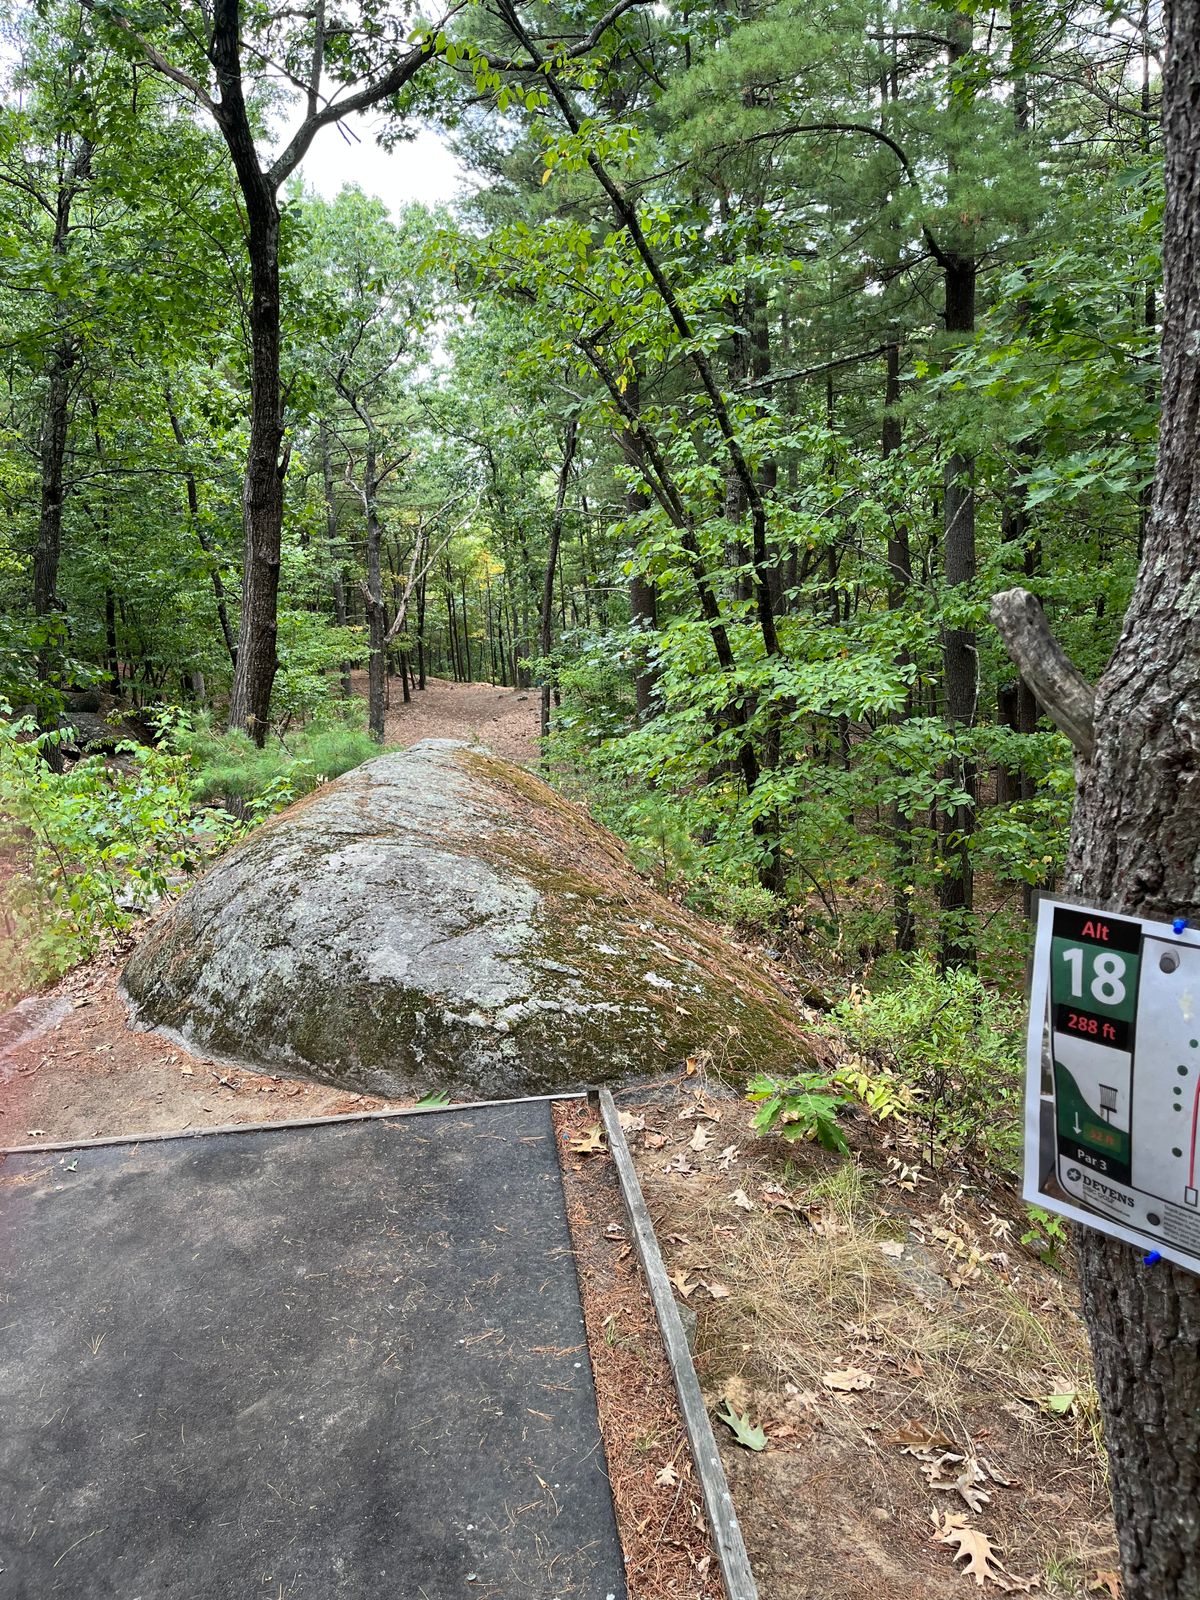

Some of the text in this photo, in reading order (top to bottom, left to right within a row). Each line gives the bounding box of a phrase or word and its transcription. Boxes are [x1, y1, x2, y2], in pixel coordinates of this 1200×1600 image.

[1082, 921, 1109, 940] Alt
[1063, 948, 1126, 1005] 18
[1068, 1014, 1115, 1040] 288 ft
[1077, 1149, 1107, 1171] Par 3
[1083, 1175, 1135, 1207] DEVENS
